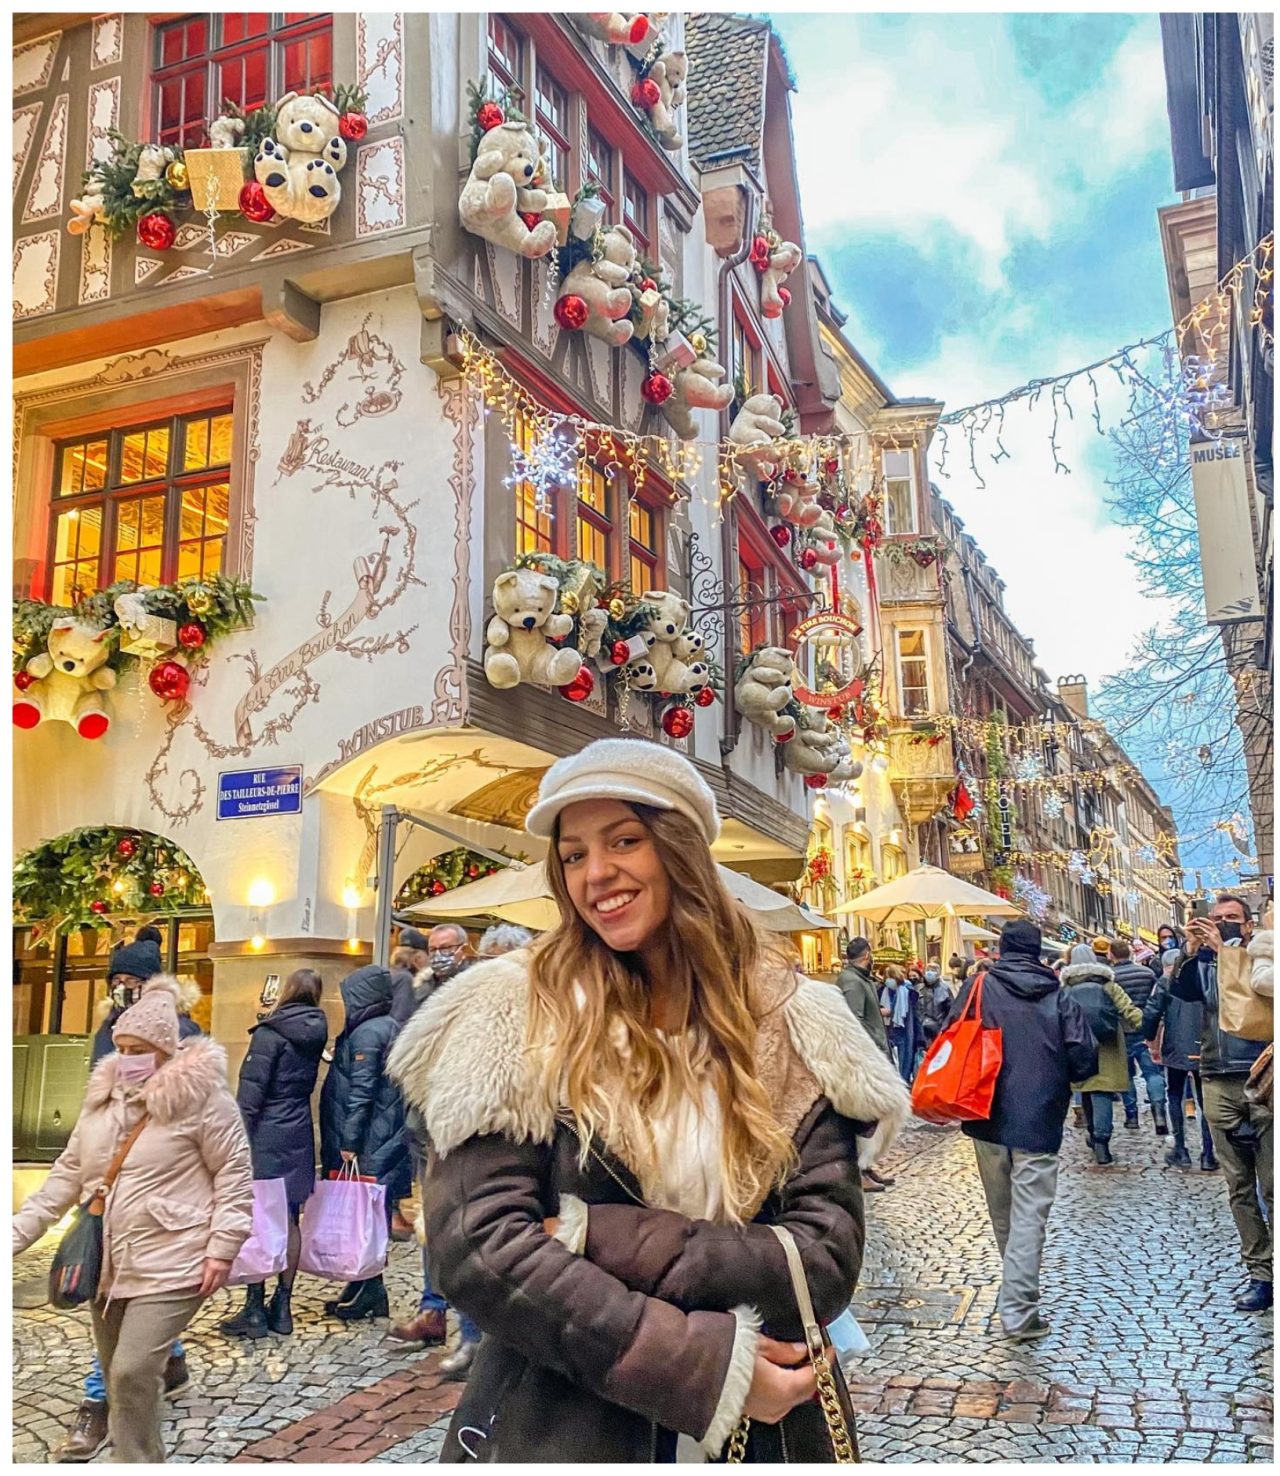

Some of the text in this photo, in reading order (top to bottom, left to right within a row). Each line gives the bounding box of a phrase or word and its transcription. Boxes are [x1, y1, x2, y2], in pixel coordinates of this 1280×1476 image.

[303, 436, 375, 482] Restaurant
[299, 613, 357, 665] Bouchon
[818, 615, 858, 631] BOUCHON
[338, 705, 424, 760] WINSTUB
[220, 783, 299, 801] DES TAILLEURS-DE-PIERRE
[253, 773, 266, 784] RUE
